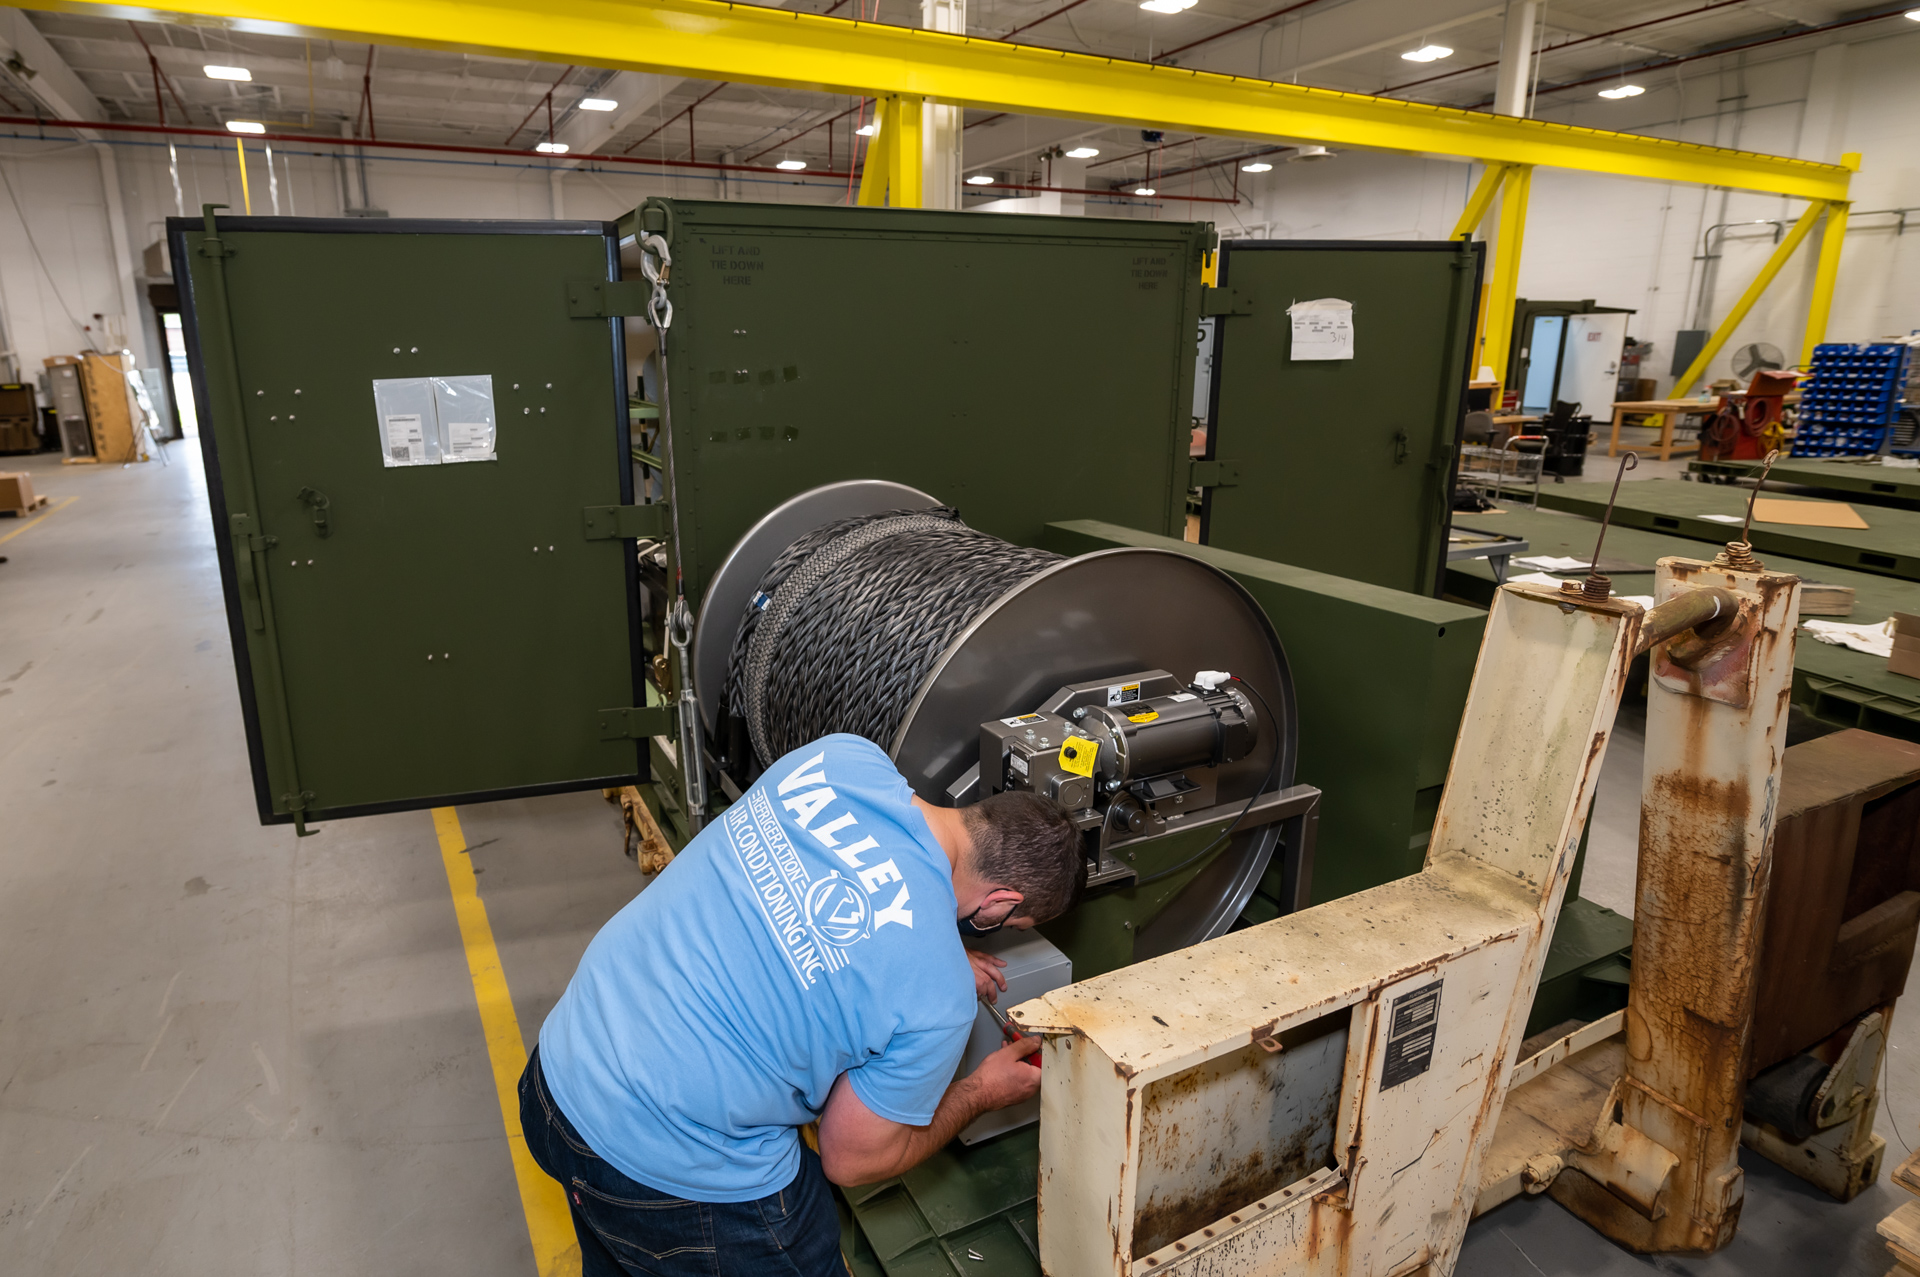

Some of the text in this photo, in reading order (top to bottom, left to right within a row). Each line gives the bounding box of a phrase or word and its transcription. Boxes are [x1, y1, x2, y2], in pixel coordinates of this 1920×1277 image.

[712, 245, 760, 256] LIFT AND
[710, 260, 763, 271] TIE DOWN
[1132, 257, 1148, 266] LIFT
[723, 275, 751, 286] HERE
[1330, 331, 1347, 347] 314
[752, 795, 804, 883] REFRIGERATION
[777, 751, 913, 932] VALLEY
[729, 804, 825, 984] AIR CONDITIONING INC.
